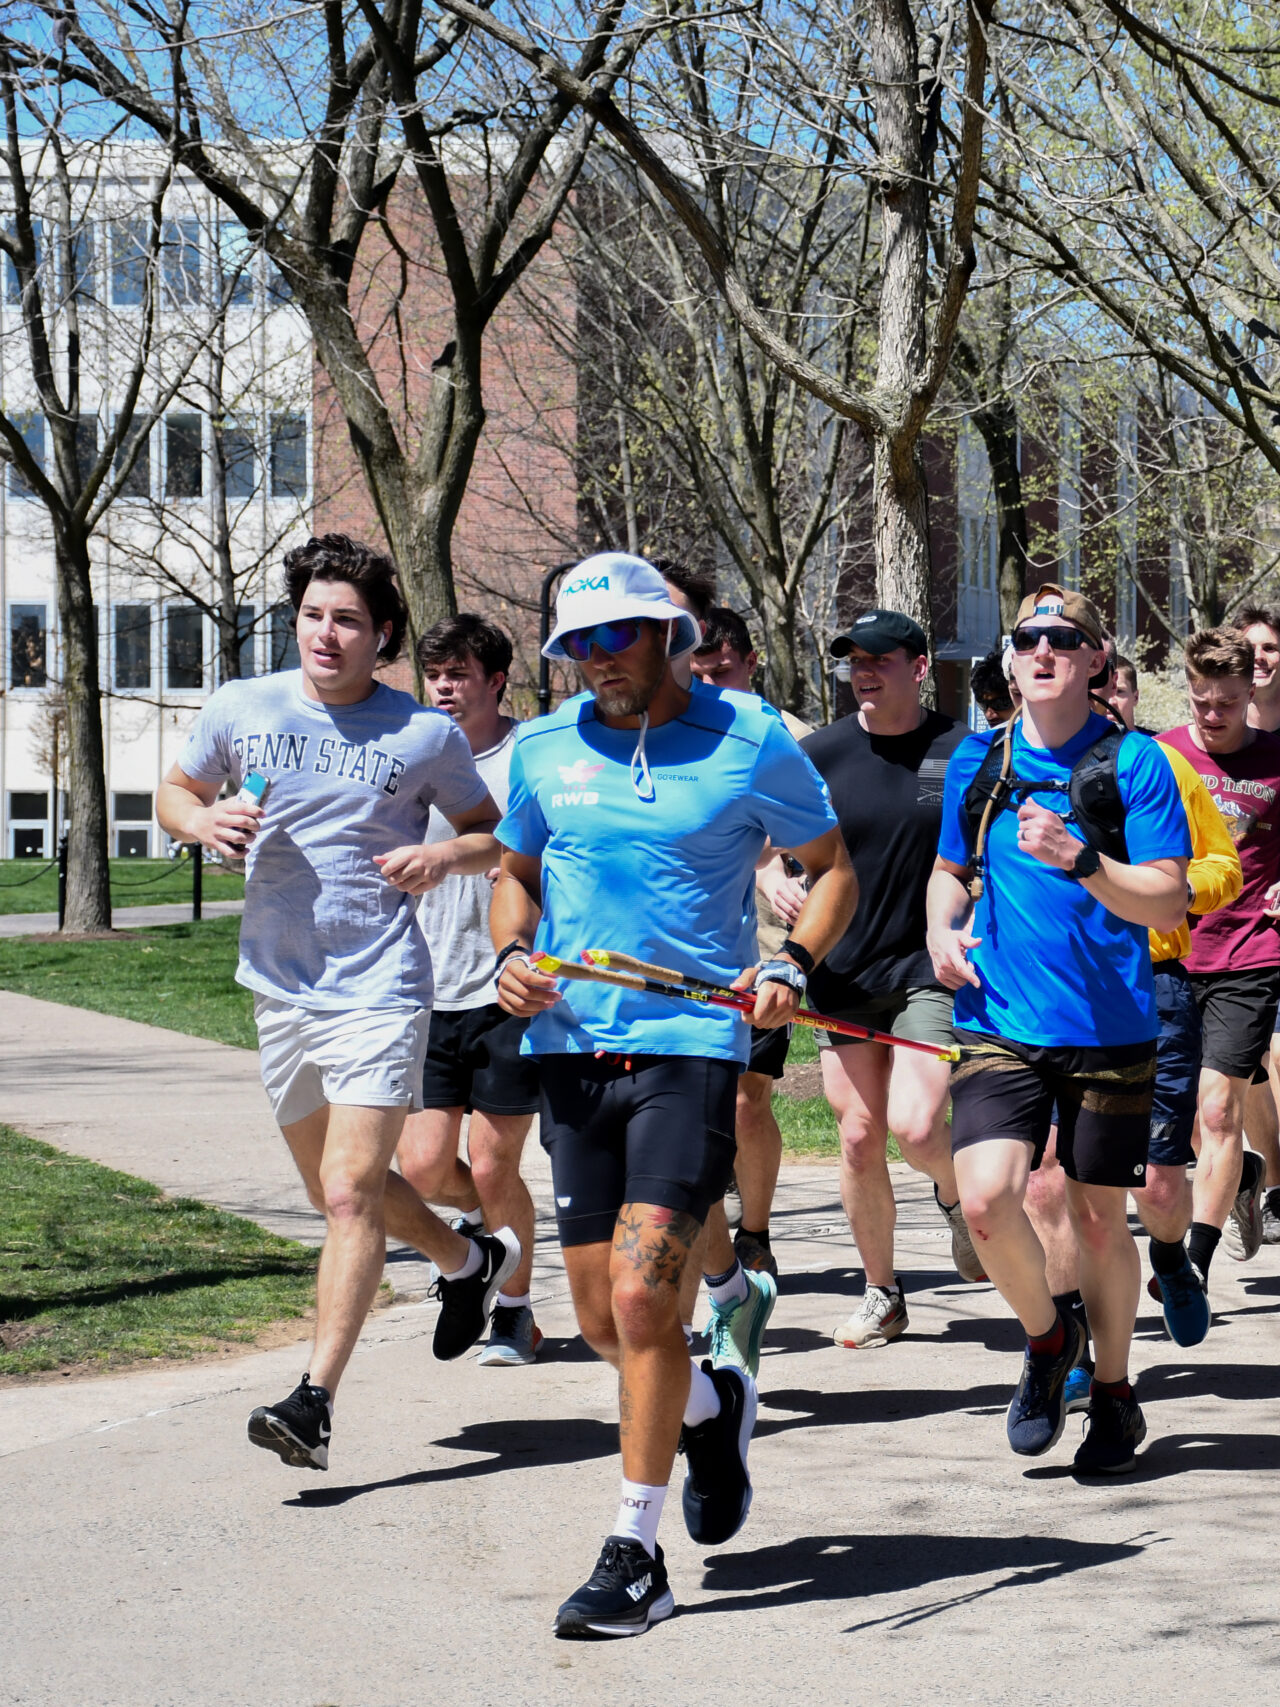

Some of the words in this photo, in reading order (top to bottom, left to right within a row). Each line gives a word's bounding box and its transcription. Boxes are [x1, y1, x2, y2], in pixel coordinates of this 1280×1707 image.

[233, 732, 308, 773] PENN
[314, 738, 406, 797] STATE
[657, 773, 699, 782] GOREWEAR
[551, 791, 599, 809] RWB
[1221, 776, 1276, 805] TETON
[683, 989, 708, 1002] LEKI
[625, 1572, 653, 1602] HOKA
